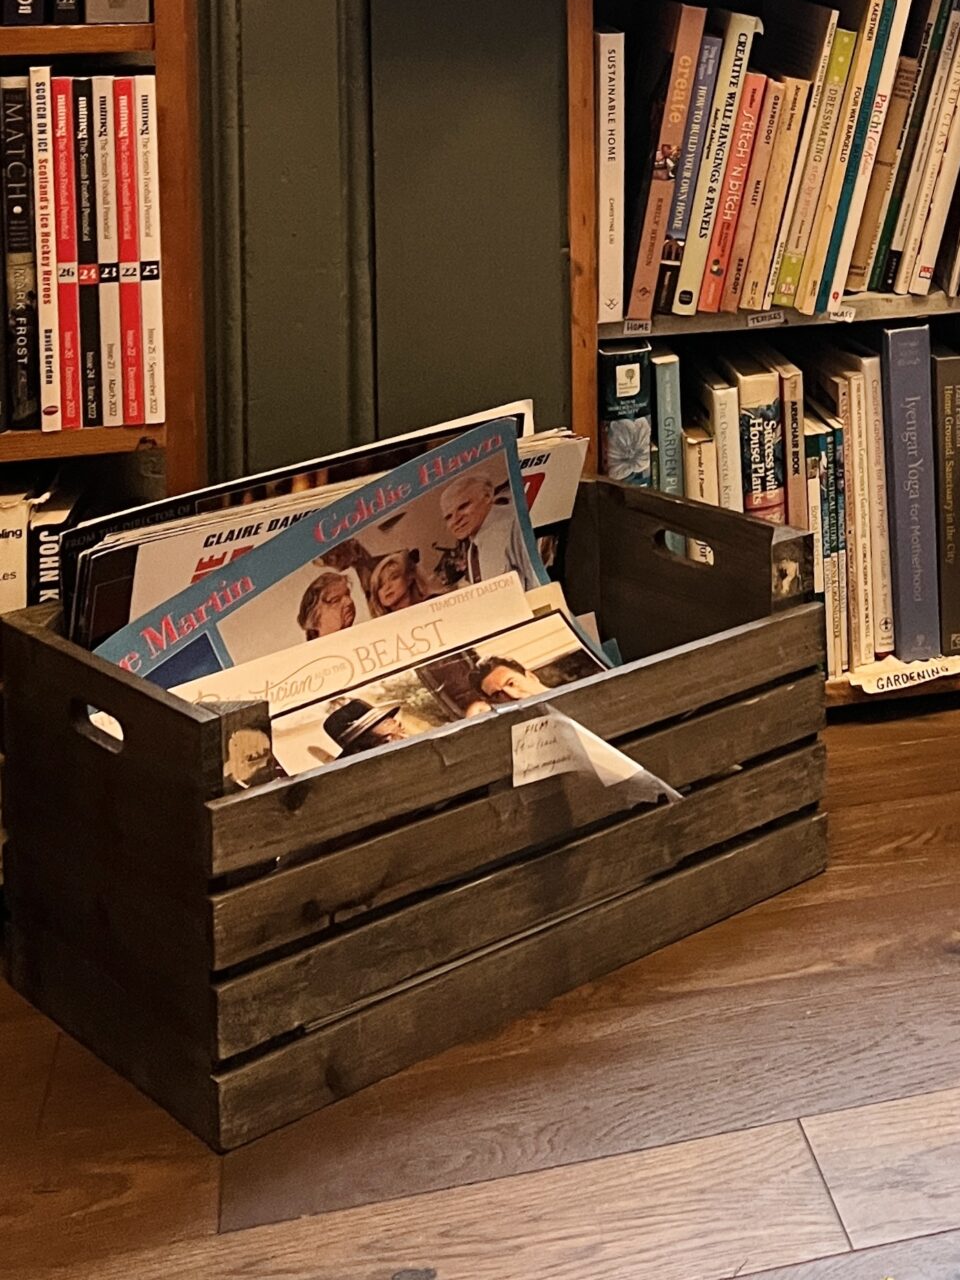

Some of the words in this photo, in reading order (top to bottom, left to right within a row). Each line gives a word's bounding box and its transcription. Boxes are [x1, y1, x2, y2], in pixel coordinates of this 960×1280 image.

[866, 2, 880, 41] KAESTNER
[729, 33, 748, 87] CREATIVE
[36, 82, 48, 120] SCOTCH
[607, 49, 616, 123] SUSTAINABLE
[668, 55, 692, 127] create.
[37, 123, 48, 135] ON
[57, 95, 67, 137] nutmeg
[78, 97, 88, 139] nutmeg
[98, 96, 108, 137] nutmeg
[118, 96, 129, 137] nutmeg
[140, 95, 150, 136] nutmeg
[812, 88, 838, 162] DRESSMAKING
[869, 93, 888, 134] Patch!
[935, 112, 952, 154] GLASS
[6, 102, 27, 199] MATCH
[38, 138, 49, 152] ICE
[607, 129, 616, 162] HOME
[709, 92, 736, 184] WALL-HANGINGS
[38, 158, 51, 210] Scotland's
[707, 186, 718, 195] &
[698, 196, 716, 239] PANELS
[41, 231, 52, 267] Hockey
[15, 268, 27, 310] MARK
[42, 270, 53, 304] Heroes
[59, 268, 74, 277] 26
[80, 268, 96, 279] 24
[122, 267, 136, 276] 22
[142, 265, 158, 276] 25
[16, 318, 27, 364] FROST
[749, 418, 762, 461] House
[764, 420, 777, 468] Success
[901, 396, 922, 456] Iyengar
[315, 486, 411, 543] Goldie
[418, 435, 502, 487] Hawn
[751, 463, 764, 505] Plants
[766, 470, 779, 498] with
[904, 459, 924, 499] Yoga
[909, 503, 920, 522] for
[39, 531, 59, 582] JOHN
[203, 525, 264, 547] CLAIRE
[911, 525, 923, 602] Motherhood
[140, 576, 256, 659] Martin
[354, 619, 445, 675] BEAST
[877, 666, 948, 690] GARDENING
